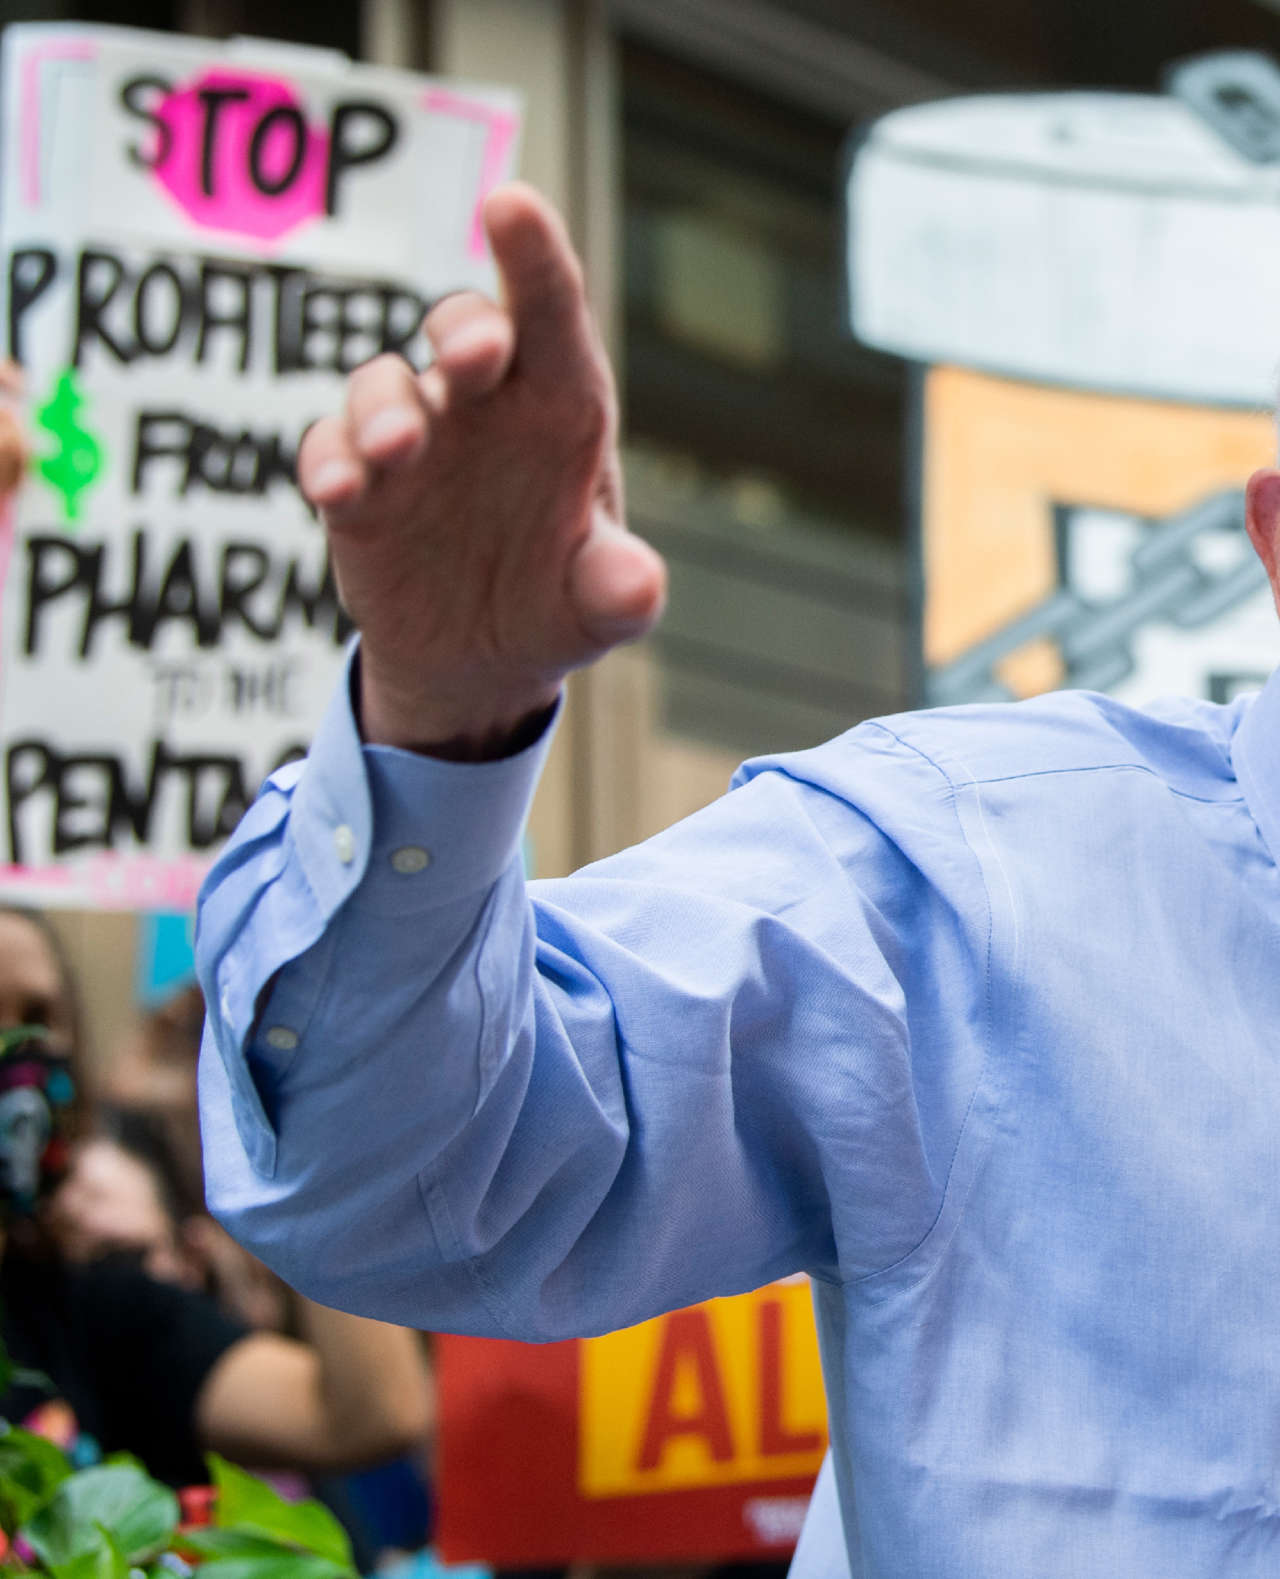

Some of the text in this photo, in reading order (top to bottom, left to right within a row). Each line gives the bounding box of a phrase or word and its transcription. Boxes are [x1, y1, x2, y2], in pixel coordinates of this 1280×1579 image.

[119, 76, 402, 218] STOP
[6, 741, 308, 866] PENTA
[636, 1300, 822, 1473] AL
